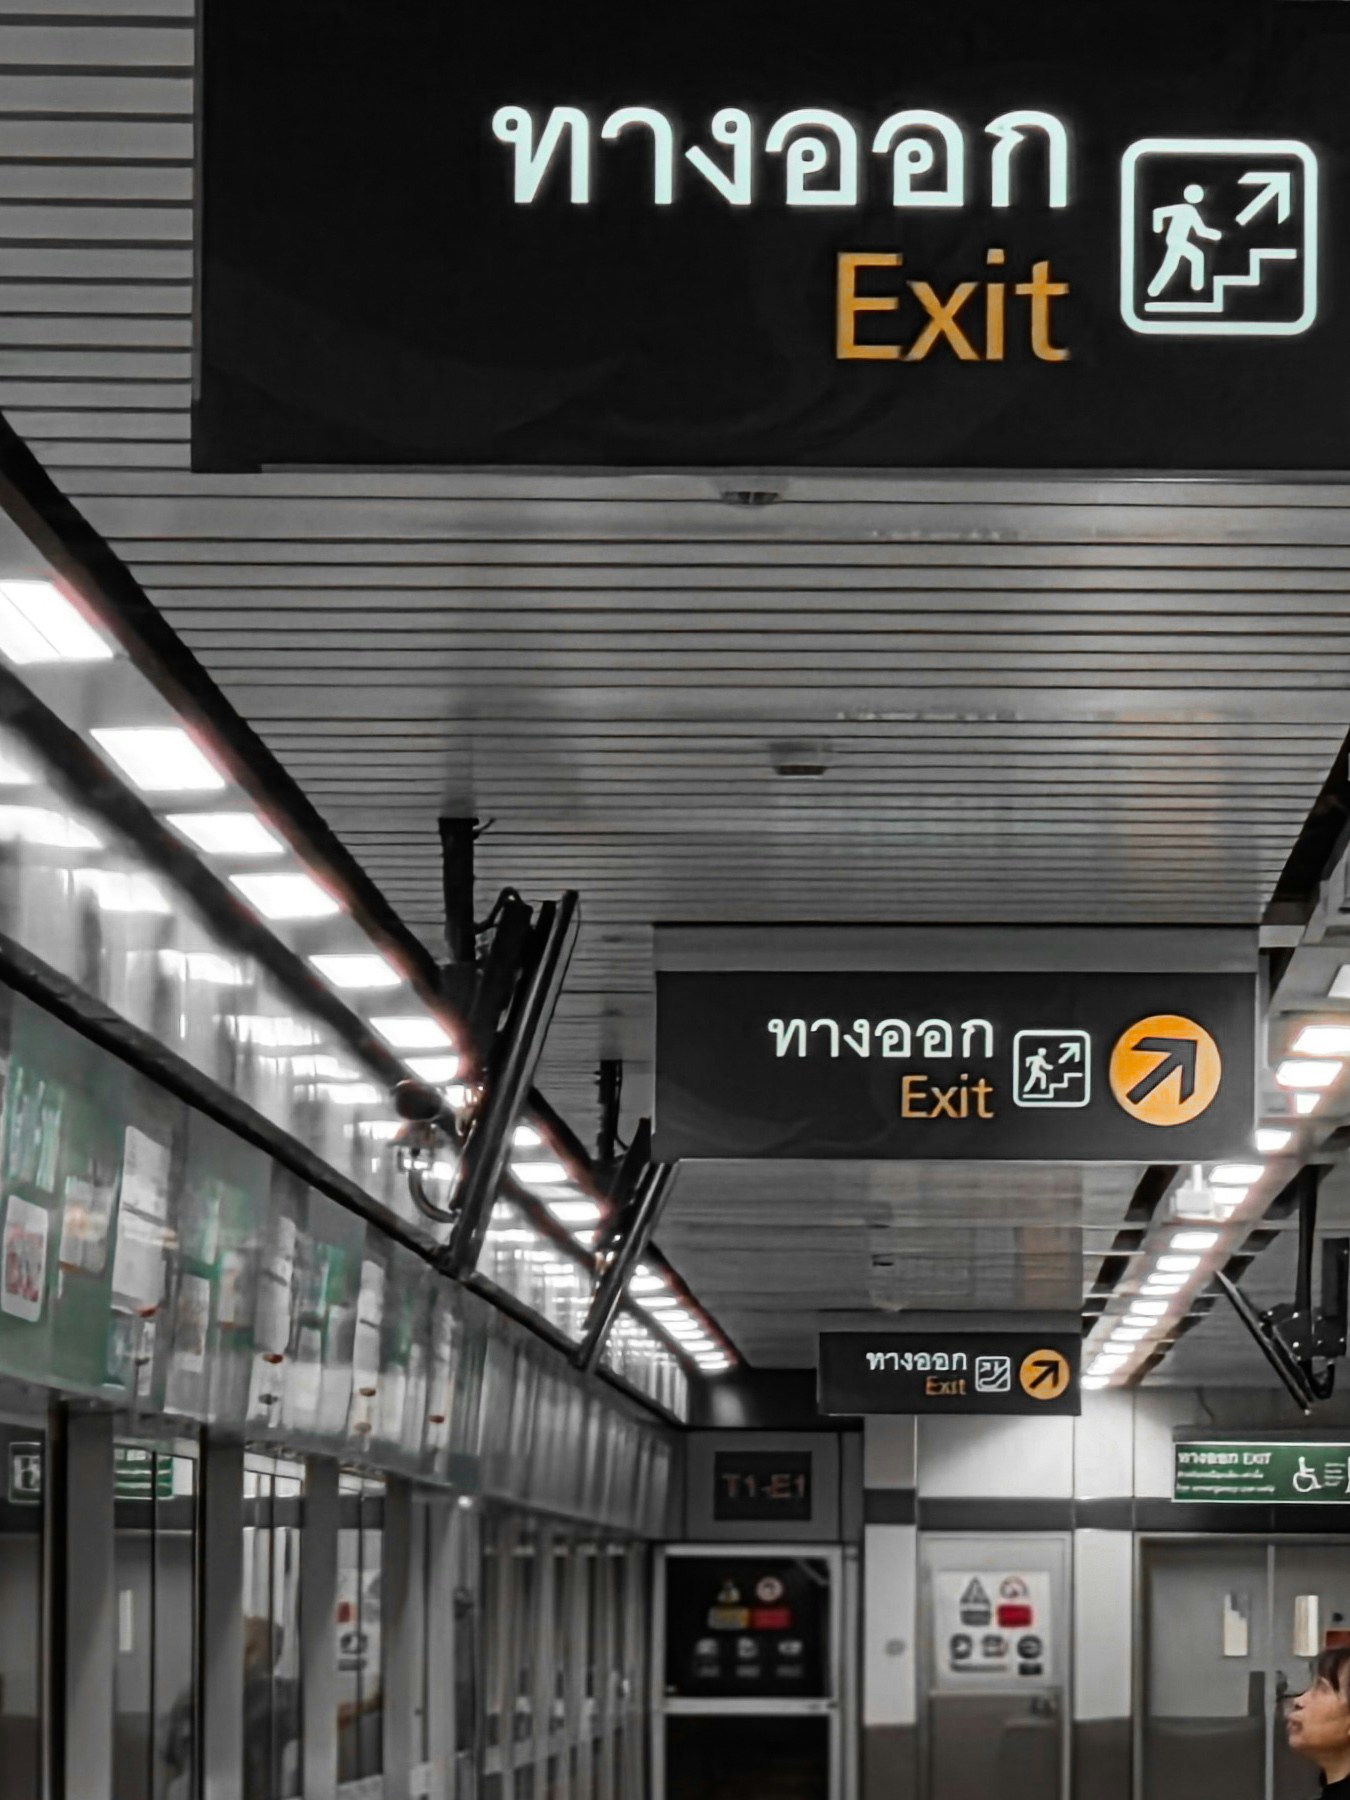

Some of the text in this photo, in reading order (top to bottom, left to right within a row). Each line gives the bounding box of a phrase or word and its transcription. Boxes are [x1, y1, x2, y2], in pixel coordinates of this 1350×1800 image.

[491, 105, 1069, 209] ทางออก
[836, 248, 1070, 363] Exit
[767, 1018, 994, 1059] ทางออก
[901, 1073, 994, 1119] Exit
[865, 1352, 968, 1371] ทางออก
[925, 1375, 967, 1396] Exit
[1243, 1452, 1272, 1465] EXIT
[721, 1473, 805, 1499] T1-E1
